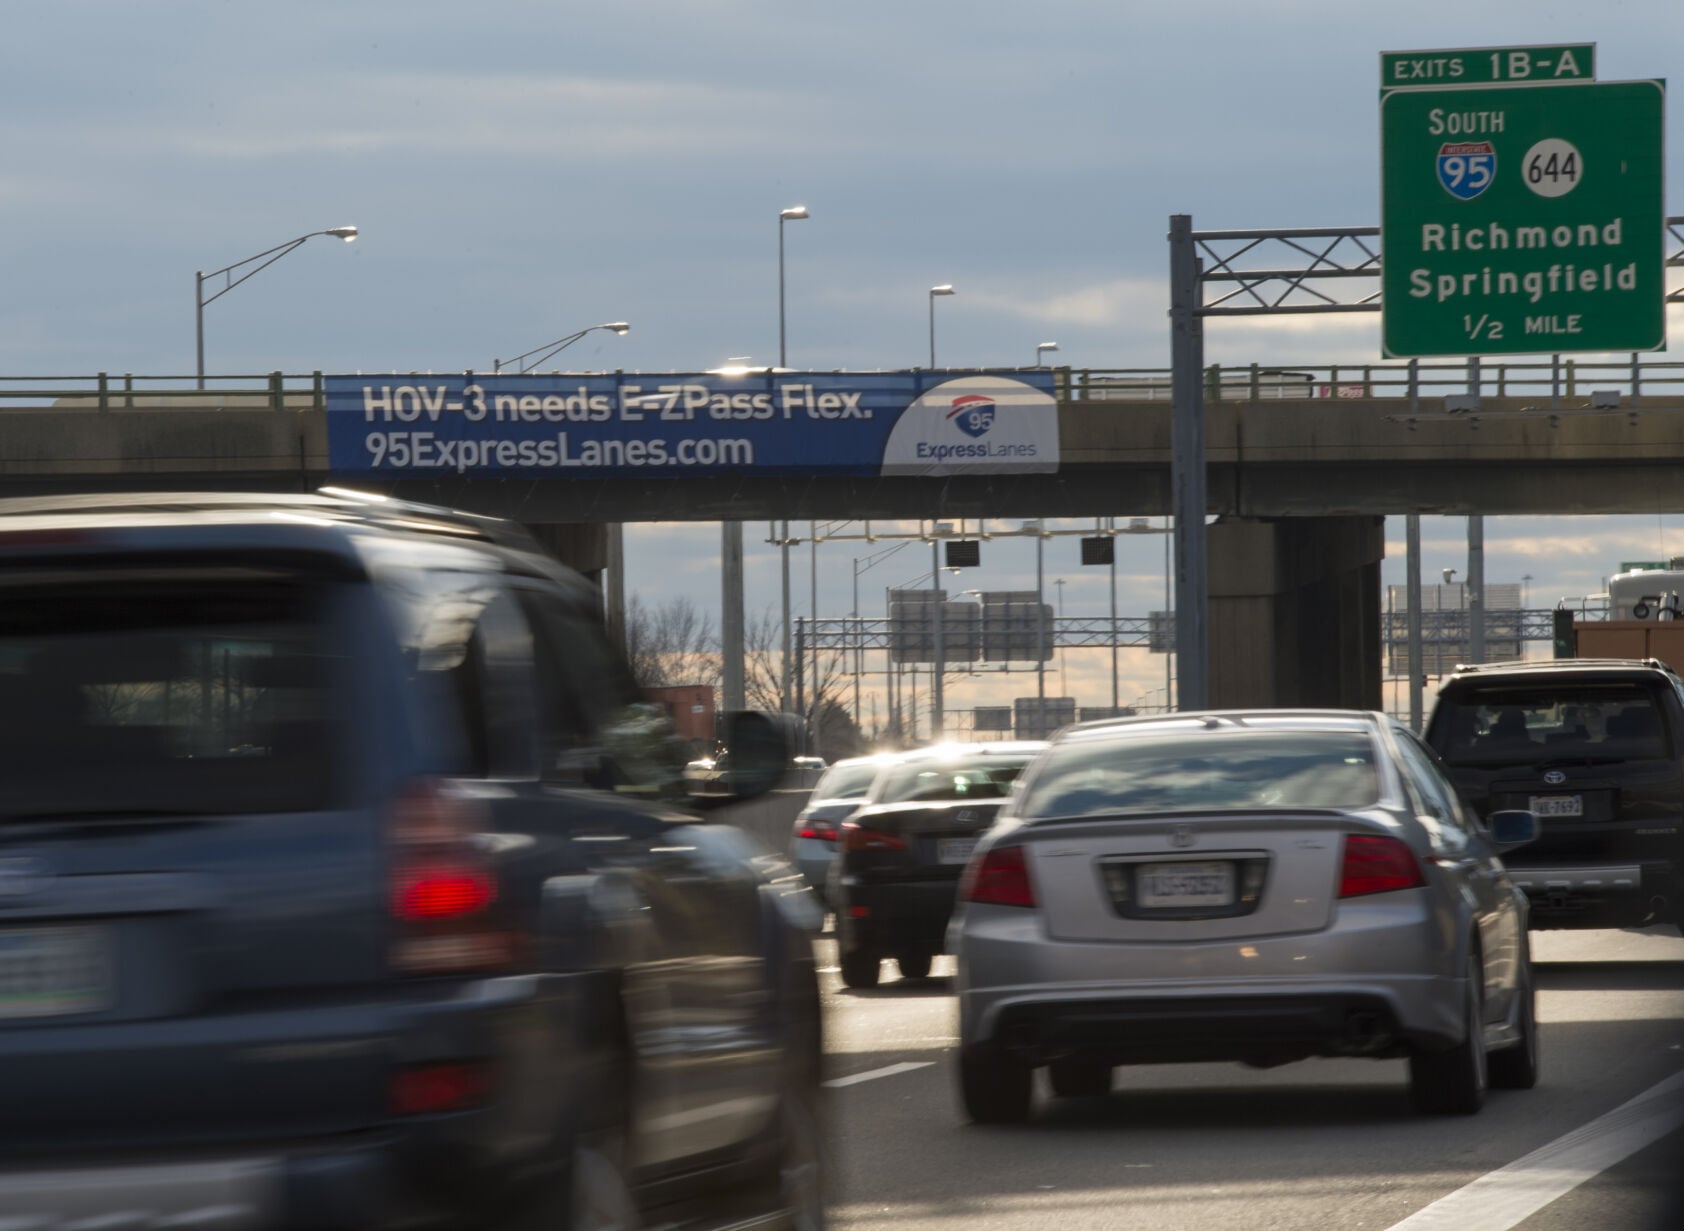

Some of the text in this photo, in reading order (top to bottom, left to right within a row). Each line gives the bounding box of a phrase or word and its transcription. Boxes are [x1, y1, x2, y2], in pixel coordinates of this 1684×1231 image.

[1394, 50, 1581, 80] EXITS 1B-A
[1428, 108, 1506, 135] SOUTH
[1443, 151, 1577, 188] 95 644
[1422, 217, 1623, 251] Richmond
[1409, 262, 1638, 303] Springfield
[1525, 314, 1583, 334] MILE
[362, 383, 873, 423] HOV-3 needs E-ZPass Flex.
[968, 412, 994, 431] 95
[365, 431, 754, 474] 95ExpressLanes.com
[916, 442, 1037, 462] ExpressLanes
